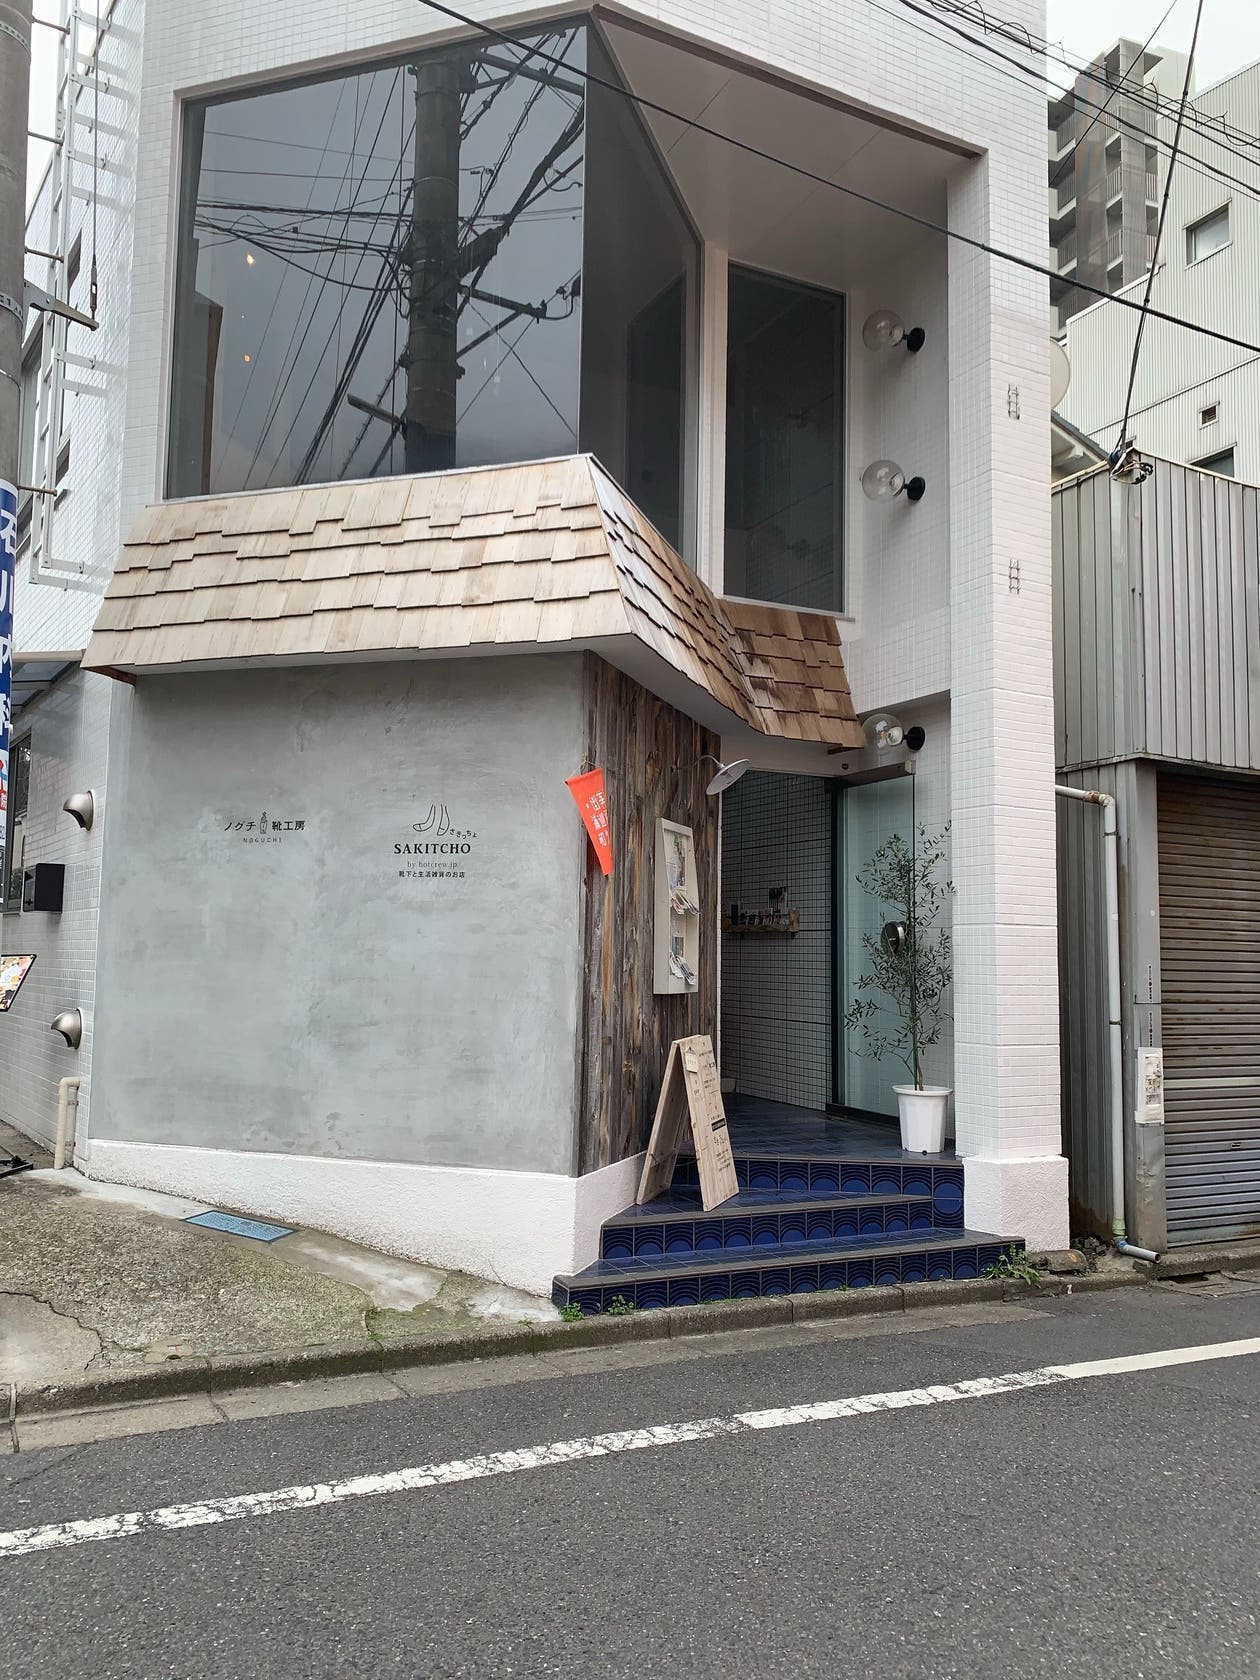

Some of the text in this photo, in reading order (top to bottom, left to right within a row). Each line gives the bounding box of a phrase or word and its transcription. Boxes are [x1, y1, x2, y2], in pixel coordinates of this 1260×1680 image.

[224, 820, 305, 831] ノグチ 靴工房
[449, 828, 478, 840] さきっちょ
[393, 843, 471, 854] SAKITCHO
[407, 860, 416, 869] by
[398, 870, 466, 879] 靴下と生活雑貨のお店
